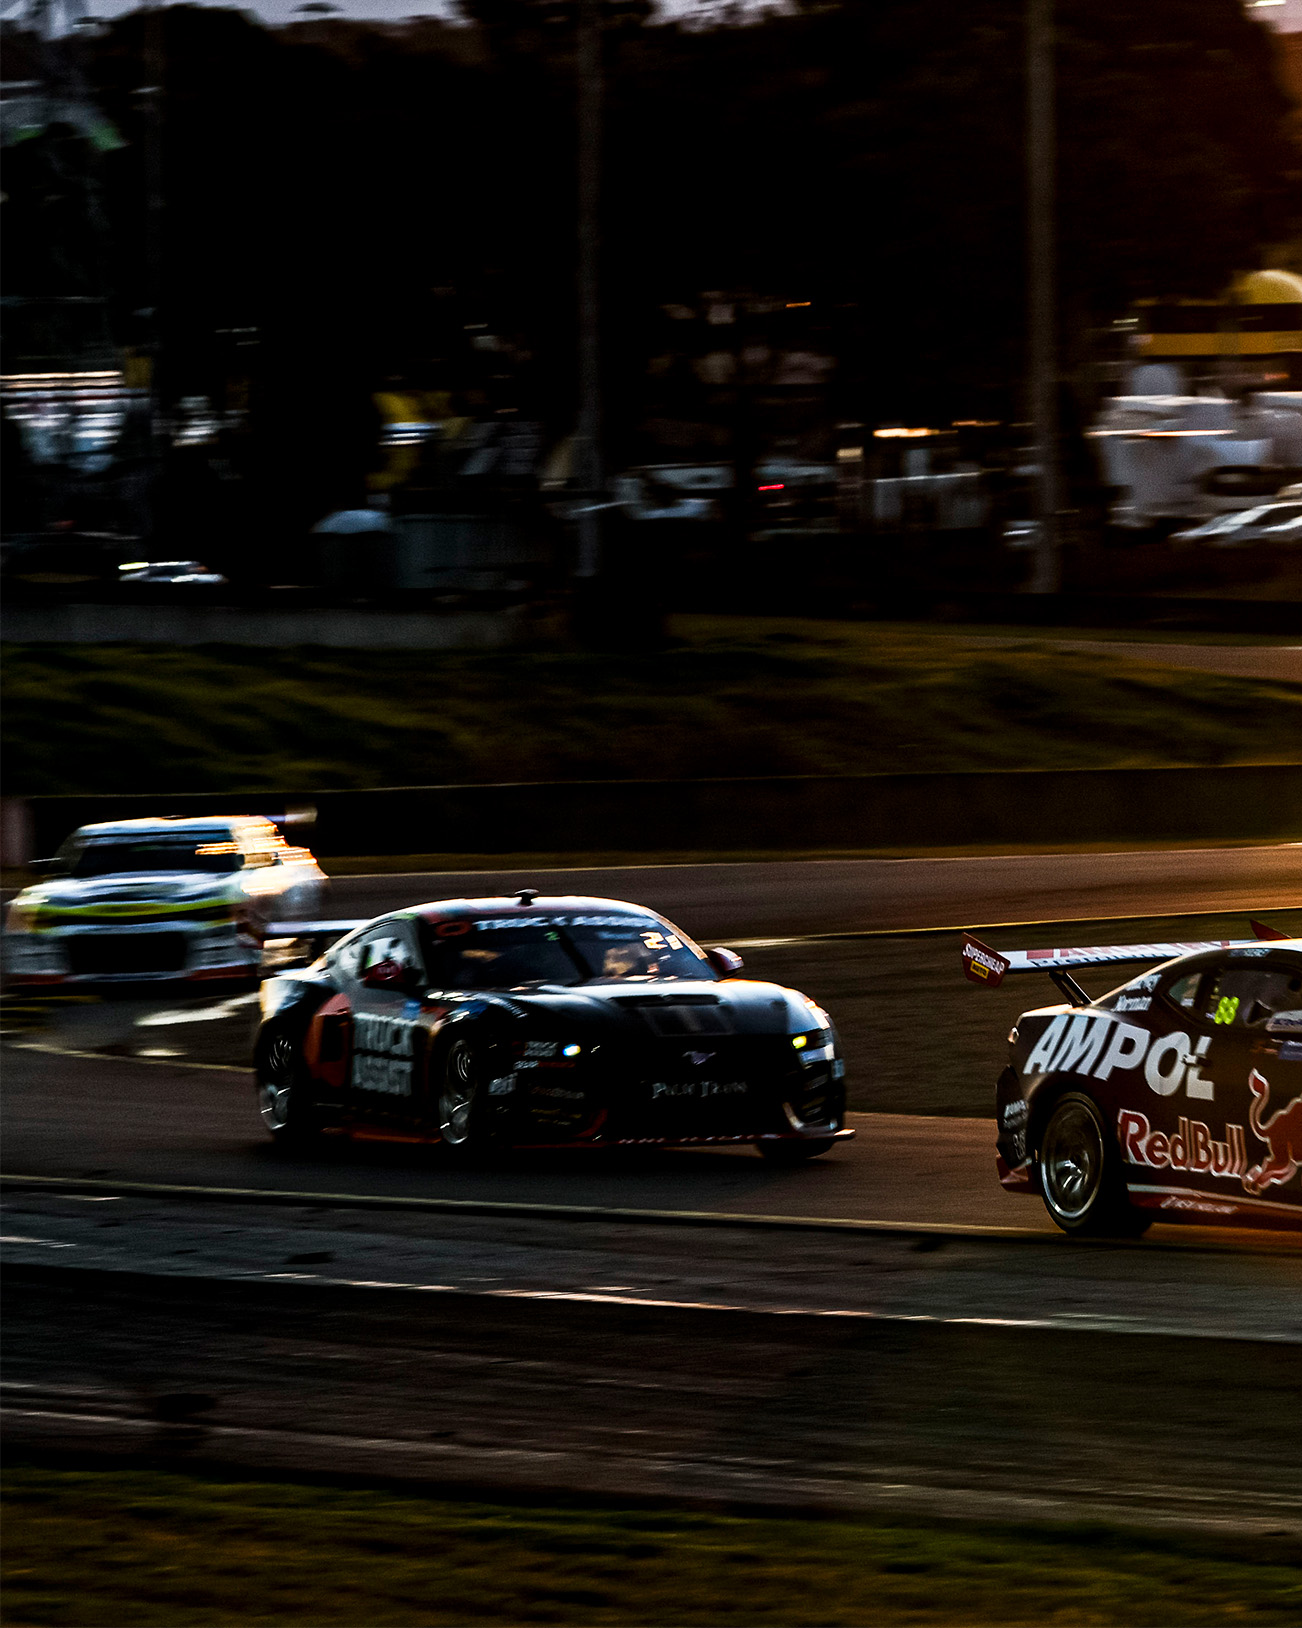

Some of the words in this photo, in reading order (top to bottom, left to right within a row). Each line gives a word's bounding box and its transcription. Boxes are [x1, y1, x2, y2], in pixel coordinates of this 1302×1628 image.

[962, 943, 1005, 975] SUPERCHEAP
[1214, 996, 1240, 1025] 88
[1023, 1014, 1215, 1101] AMPOL
